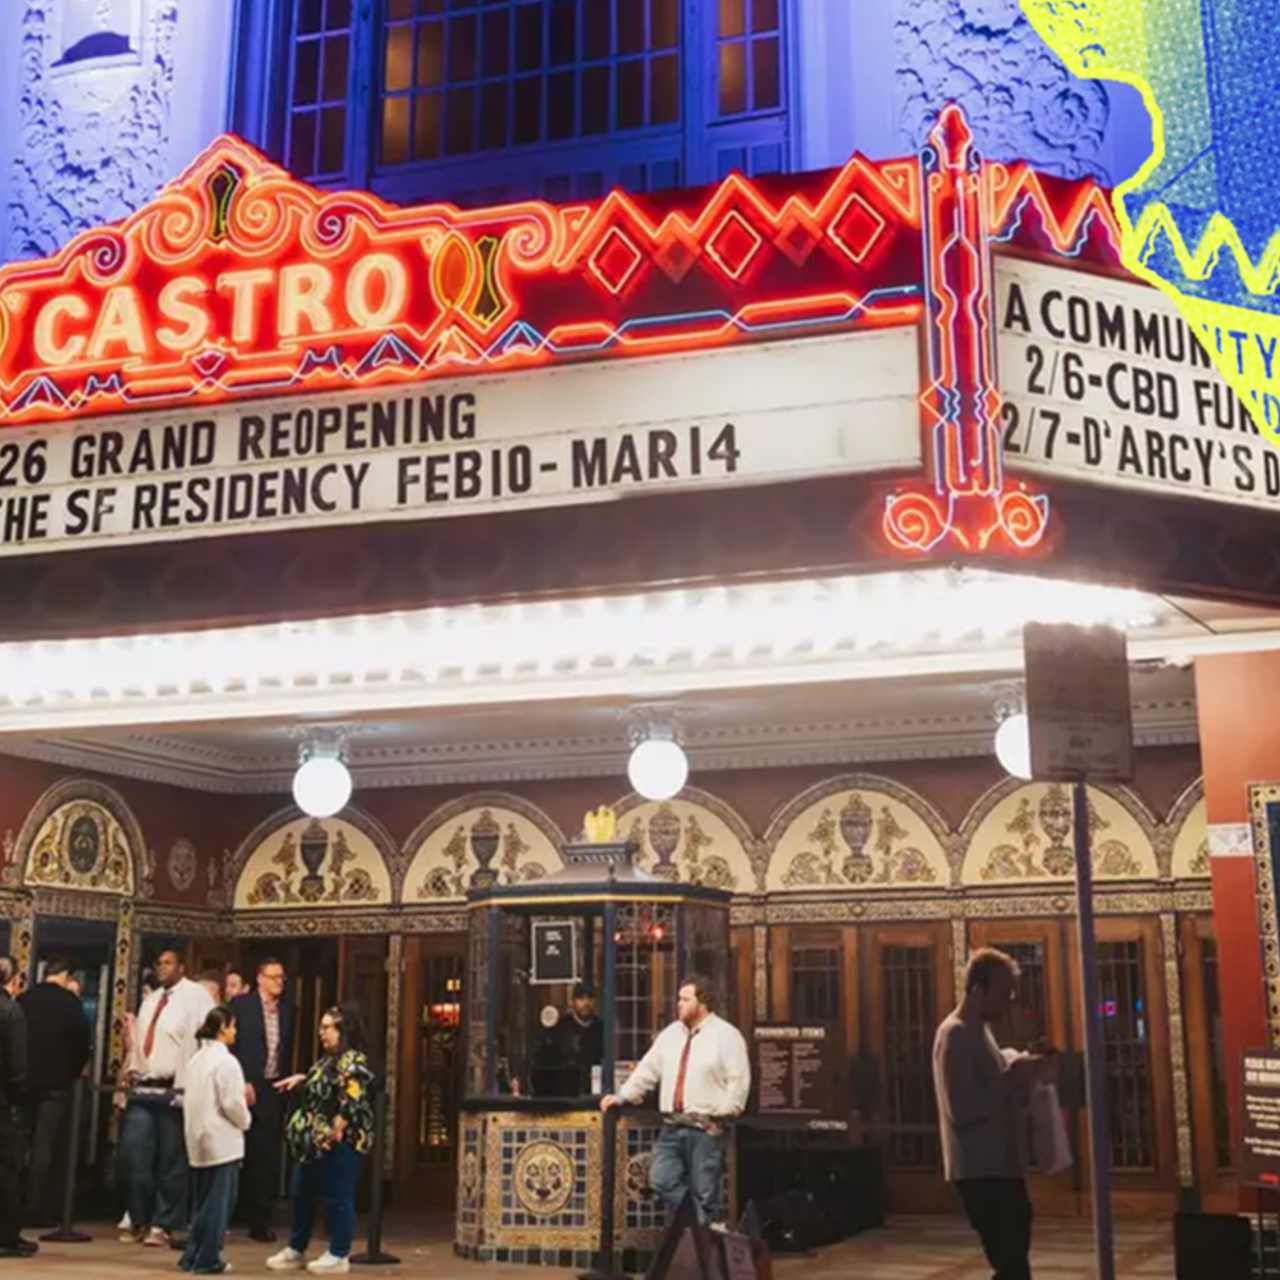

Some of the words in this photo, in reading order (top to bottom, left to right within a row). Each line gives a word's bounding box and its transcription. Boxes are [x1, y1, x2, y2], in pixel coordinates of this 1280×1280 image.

[33, 253, 409, 365] CASTRO
[1003, 282, 1032, 333] A
[1040, 289, 1277, 380] COMMUNITY
[70, 420, 217, 479] GRAND
[237, 393, 477, 461] REOPENING
[65, 487, 117, 536] SF
[131, 461, 371, 530] RESIDENCY
